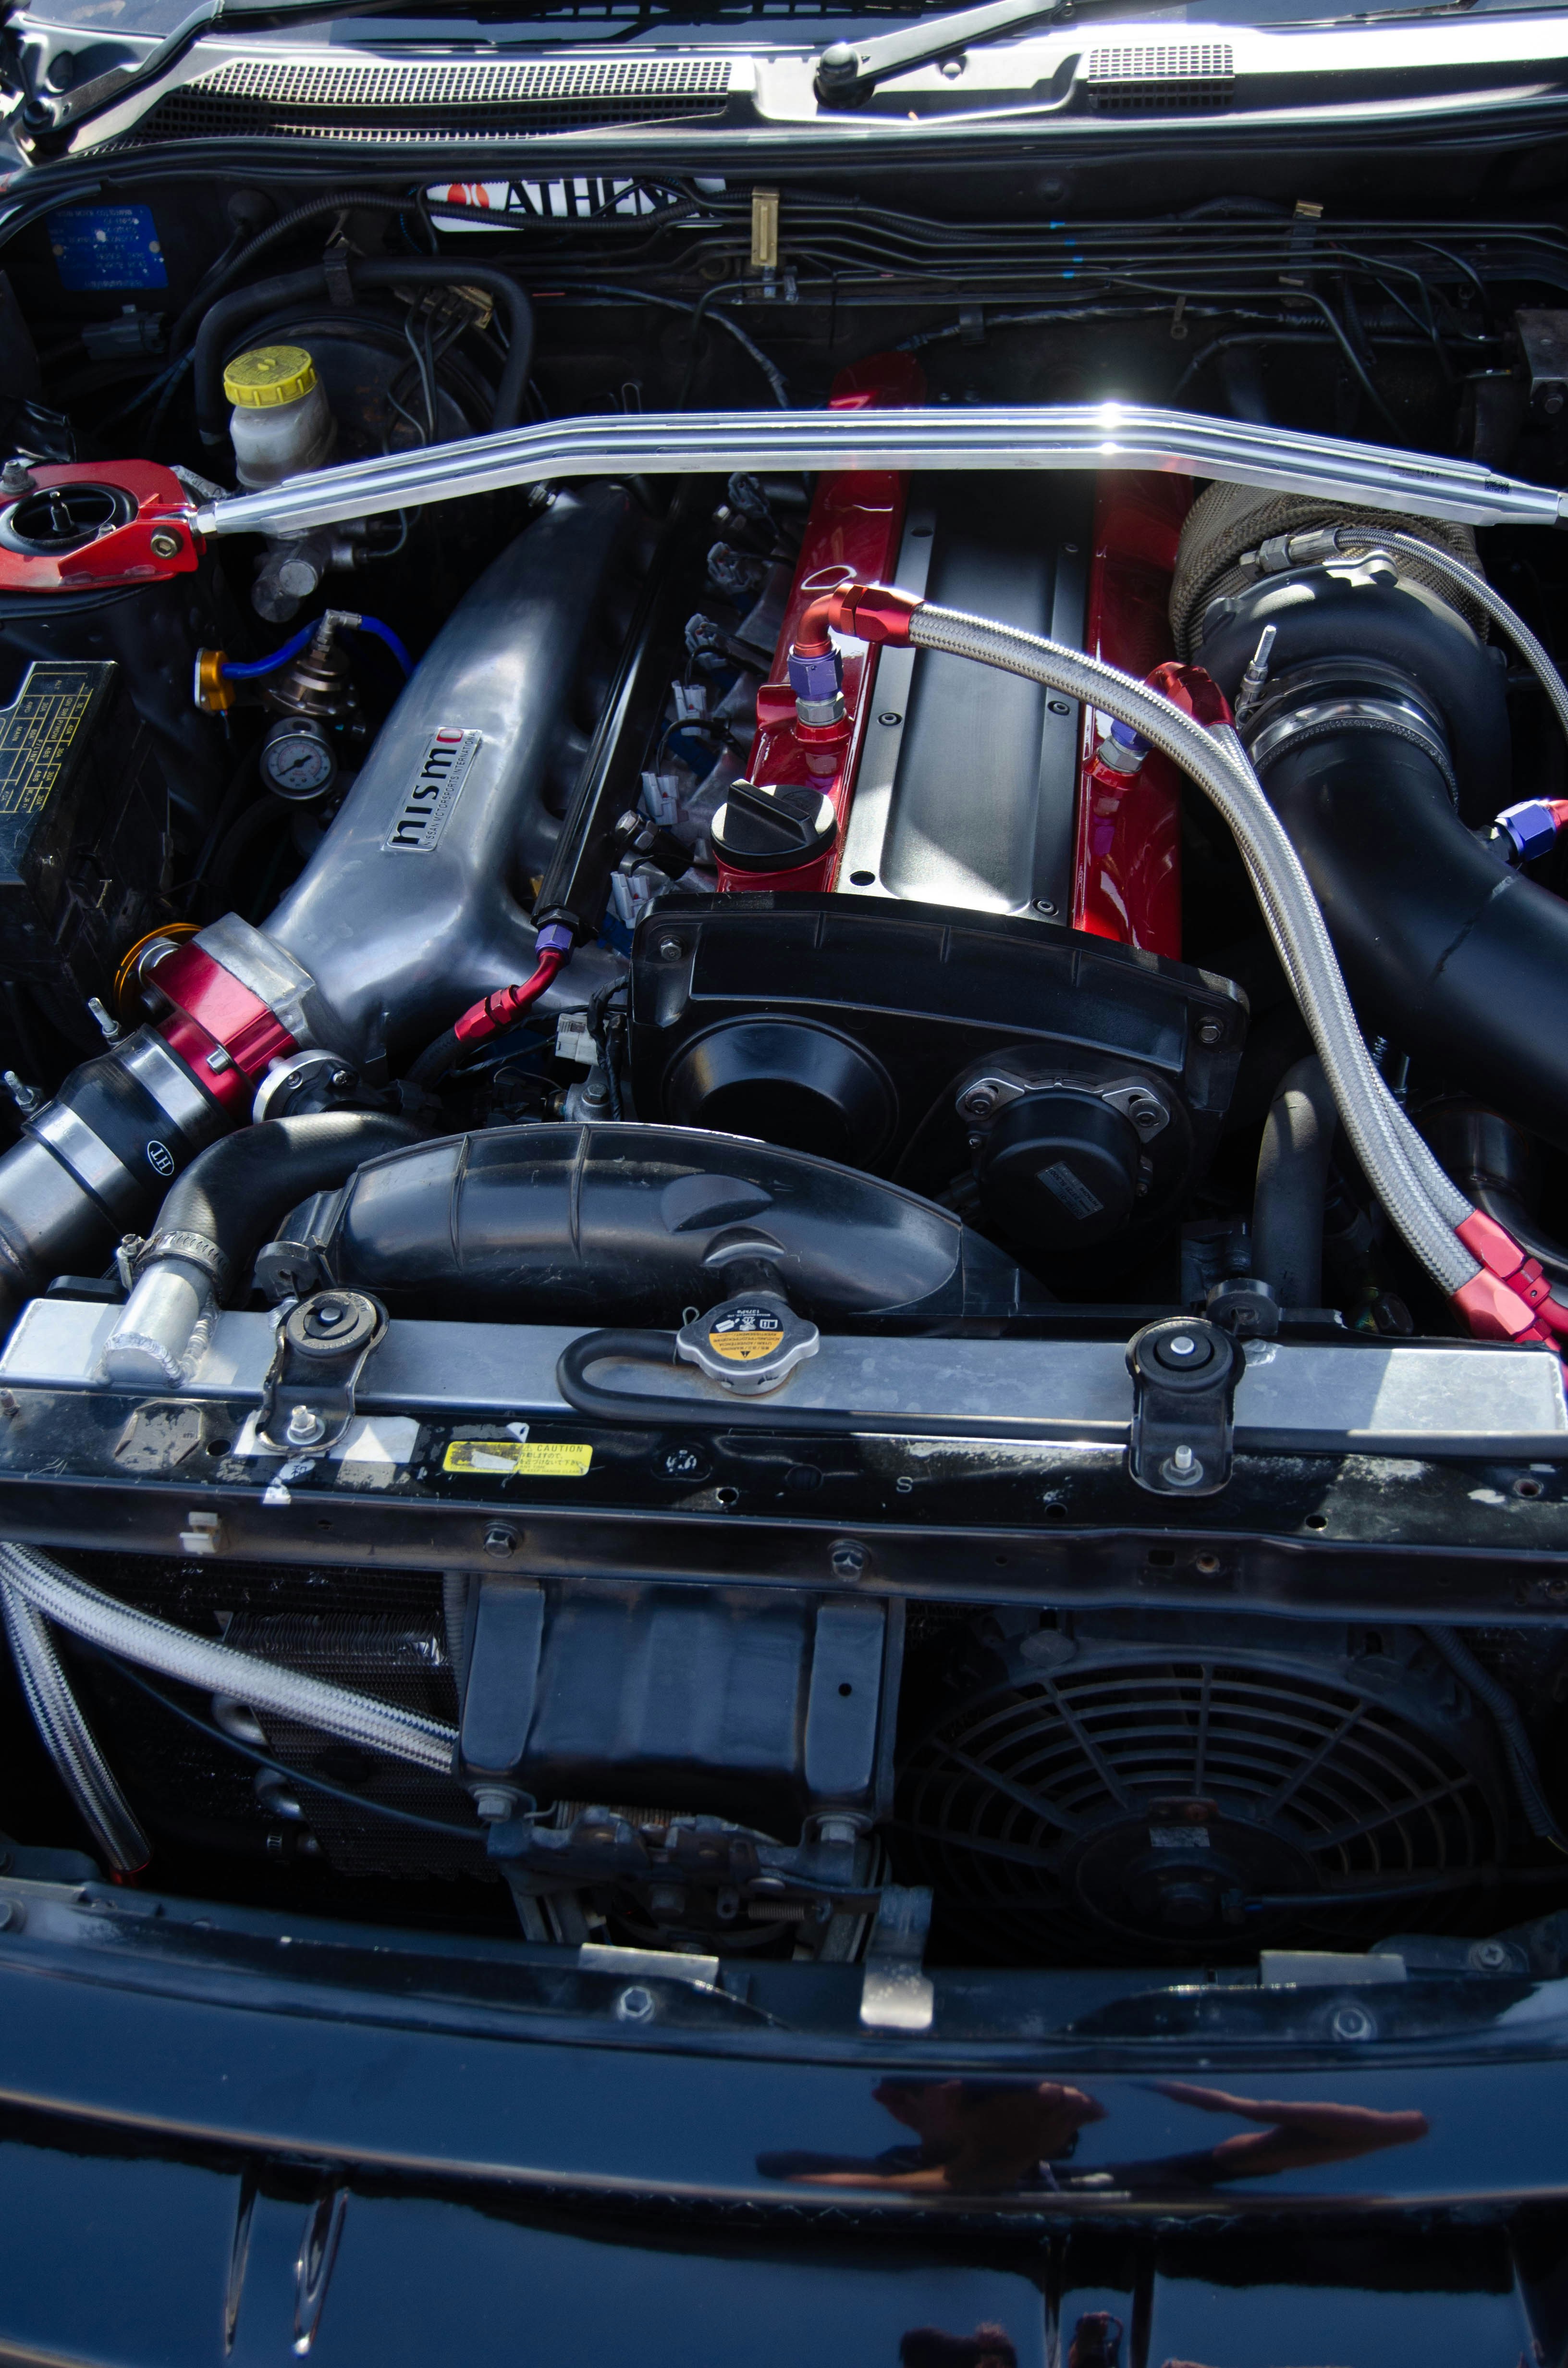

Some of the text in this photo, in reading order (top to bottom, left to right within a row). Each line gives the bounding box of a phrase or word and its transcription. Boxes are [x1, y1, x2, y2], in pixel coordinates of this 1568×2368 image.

[12, 726, 23, 742] MAIN
[65, 724, 74, 735] 40A
[28, 739, 43, 763] F/LINK
[43, 746, 52, 759] ABS
[55, 747, 64, 758] 30A
[33, 770, 42, 782] ABS
[46, 771, 55, 781] 30A
[392, 728, 464, 845] nismo
[423, 729, 478, 846] NISSAN MOTORSPORTS INTERNATIONAL
[35, 795, 44, 805] 30A
